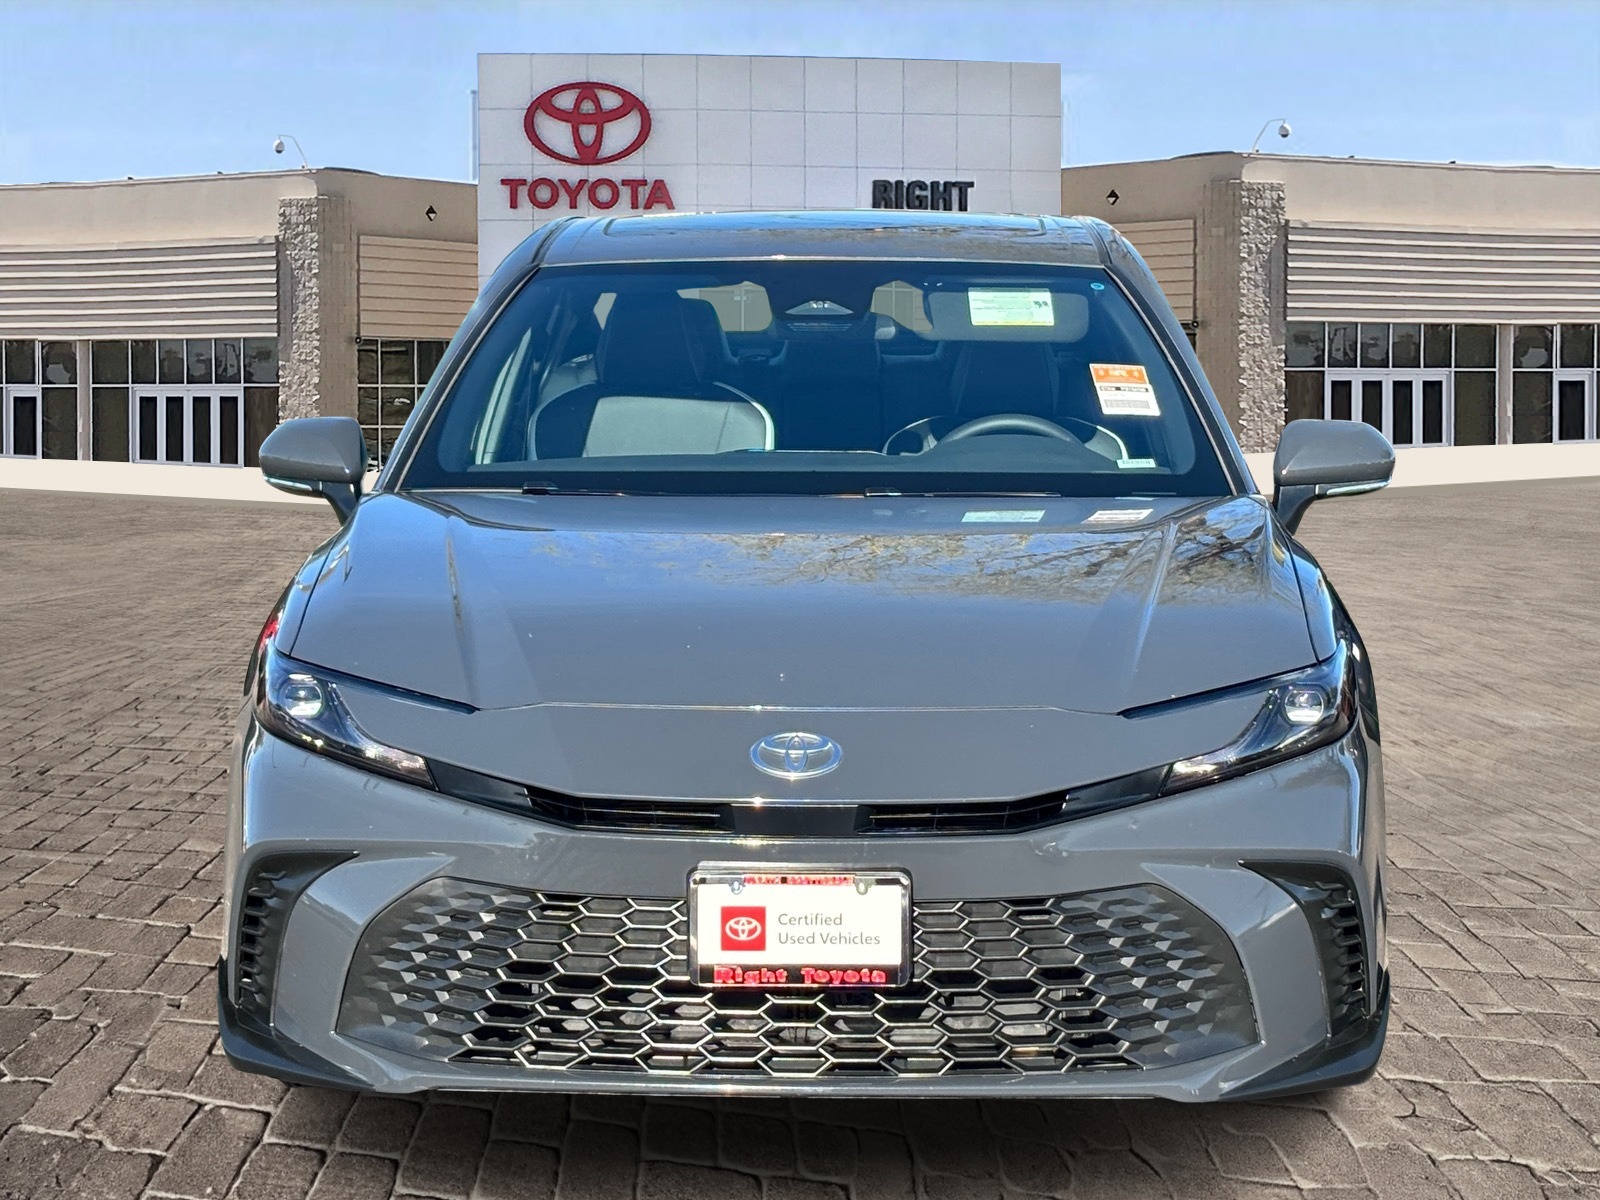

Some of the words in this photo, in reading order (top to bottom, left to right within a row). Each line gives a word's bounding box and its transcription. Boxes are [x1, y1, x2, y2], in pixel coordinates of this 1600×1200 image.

[500, 178, 675, 209] TOYOTA
[872, 180, 974, 211] RIGHT
[778, 913, 843, 926] Certified
[778, 932, 815, 945] Used
[820, 932, 880, 945] Vehicles
[714, 965, 787, 984] Right
[801, 967, 886, 984] Toyota
